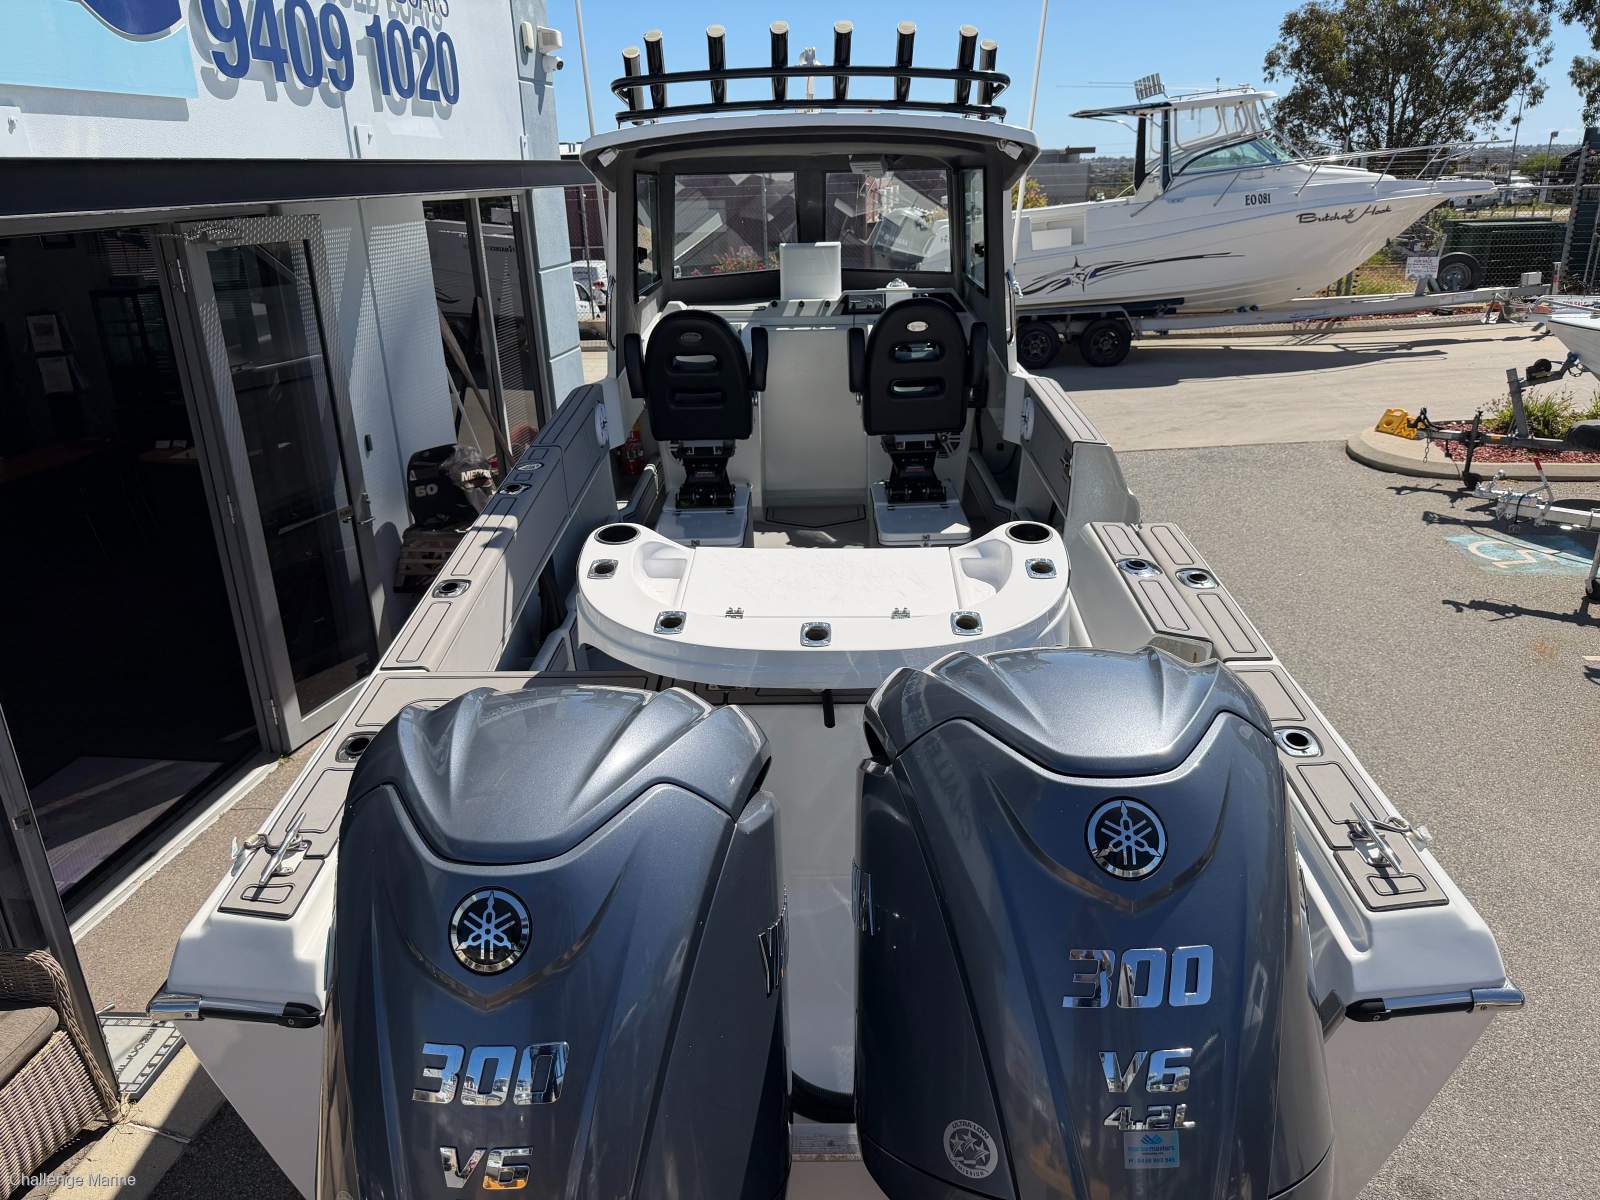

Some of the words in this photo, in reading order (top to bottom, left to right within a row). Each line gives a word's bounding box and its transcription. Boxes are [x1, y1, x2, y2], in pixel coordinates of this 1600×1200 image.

[201, 0, 354, 91] 9409
[365, 15, 459, 104] 1020
[1062, 944, 1214, 1009] 300
[412, 1041, 569, 1106] 300
[1099, 1047, 1194, 1093] V6
[1103, 1103, 1196, 1130] 4.2L
[440, 1146, 533, 1190] V6
